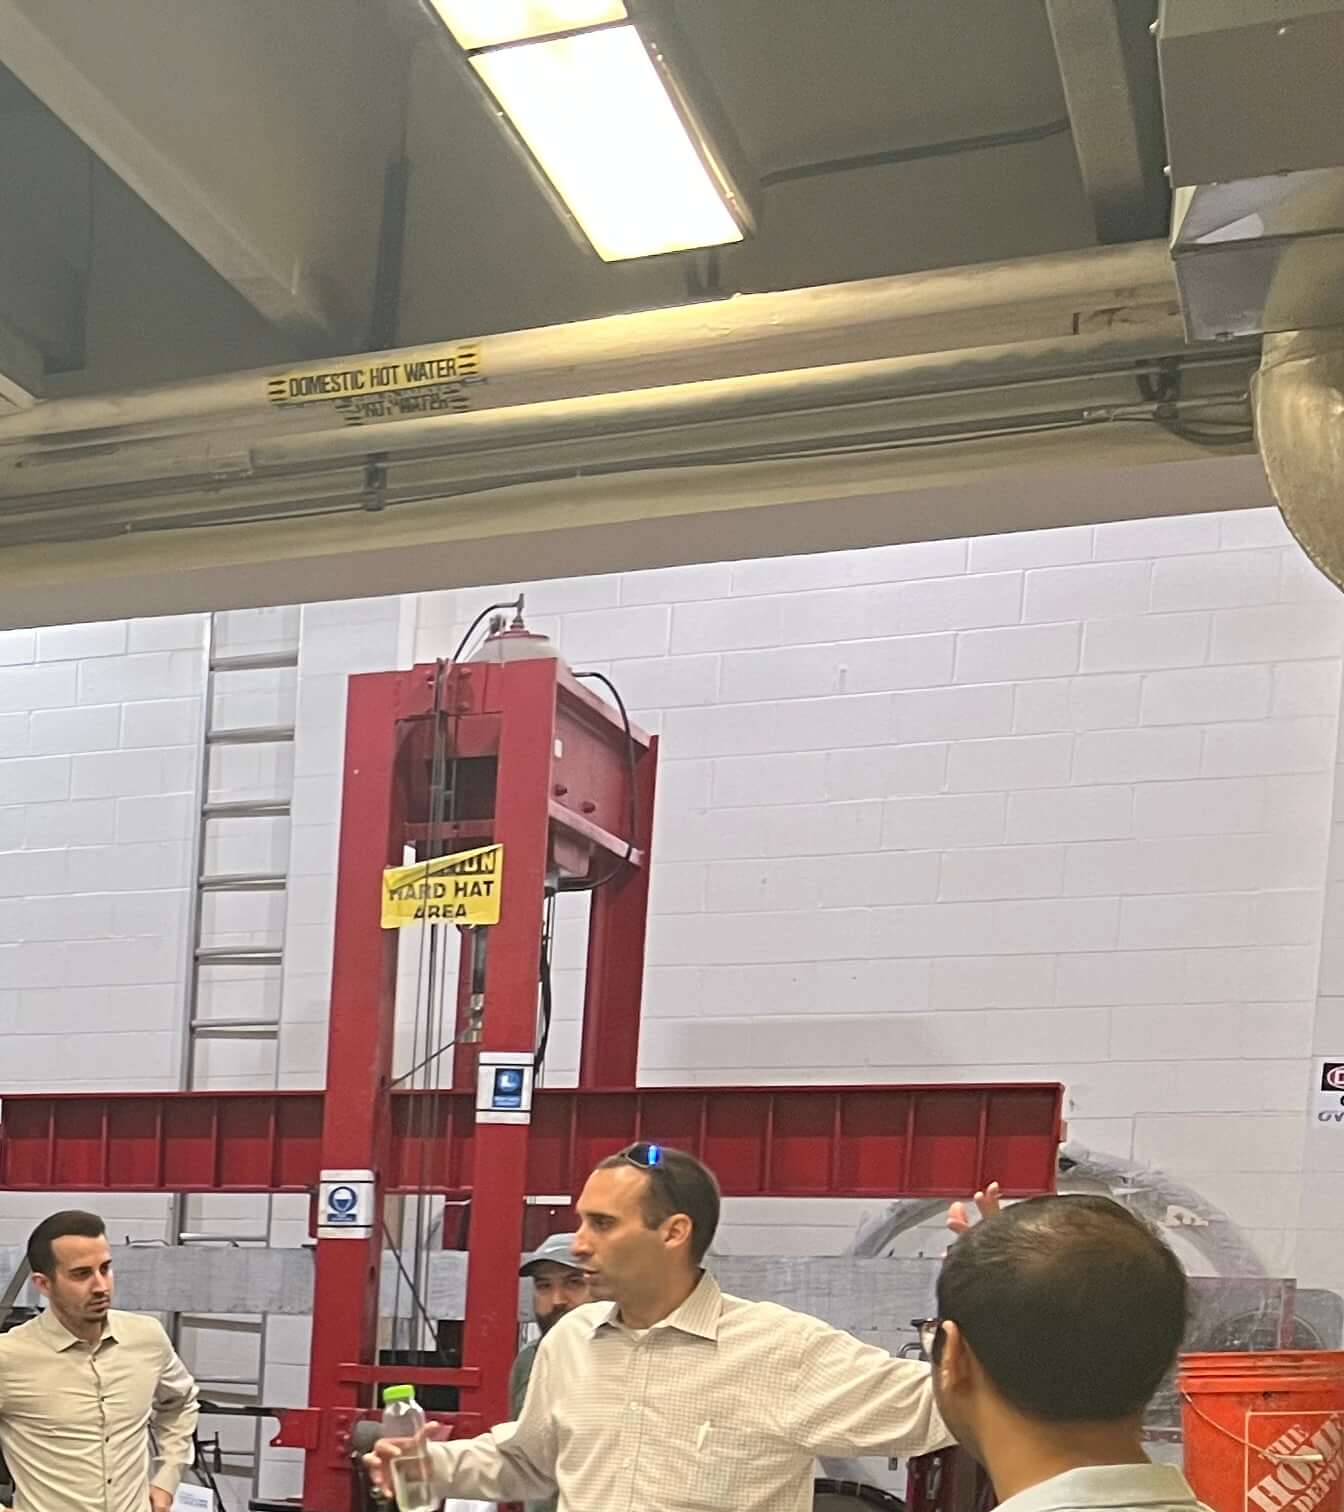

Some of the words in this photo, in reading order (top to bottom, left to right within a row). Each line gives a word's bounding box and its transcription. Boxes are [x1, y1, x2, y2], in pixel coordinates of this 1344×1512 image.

[289, 371, 365, 397] DOMESTIC
[370, 365, 399, 388] HOT
[404, 358, 457, 382] WATER
[389, 883, 446, 900] HARD
[455, 881, 494, 897] HAT
[414, 904, 467, 919] AREA
[1258, 1424, 1309, 1465] THE
